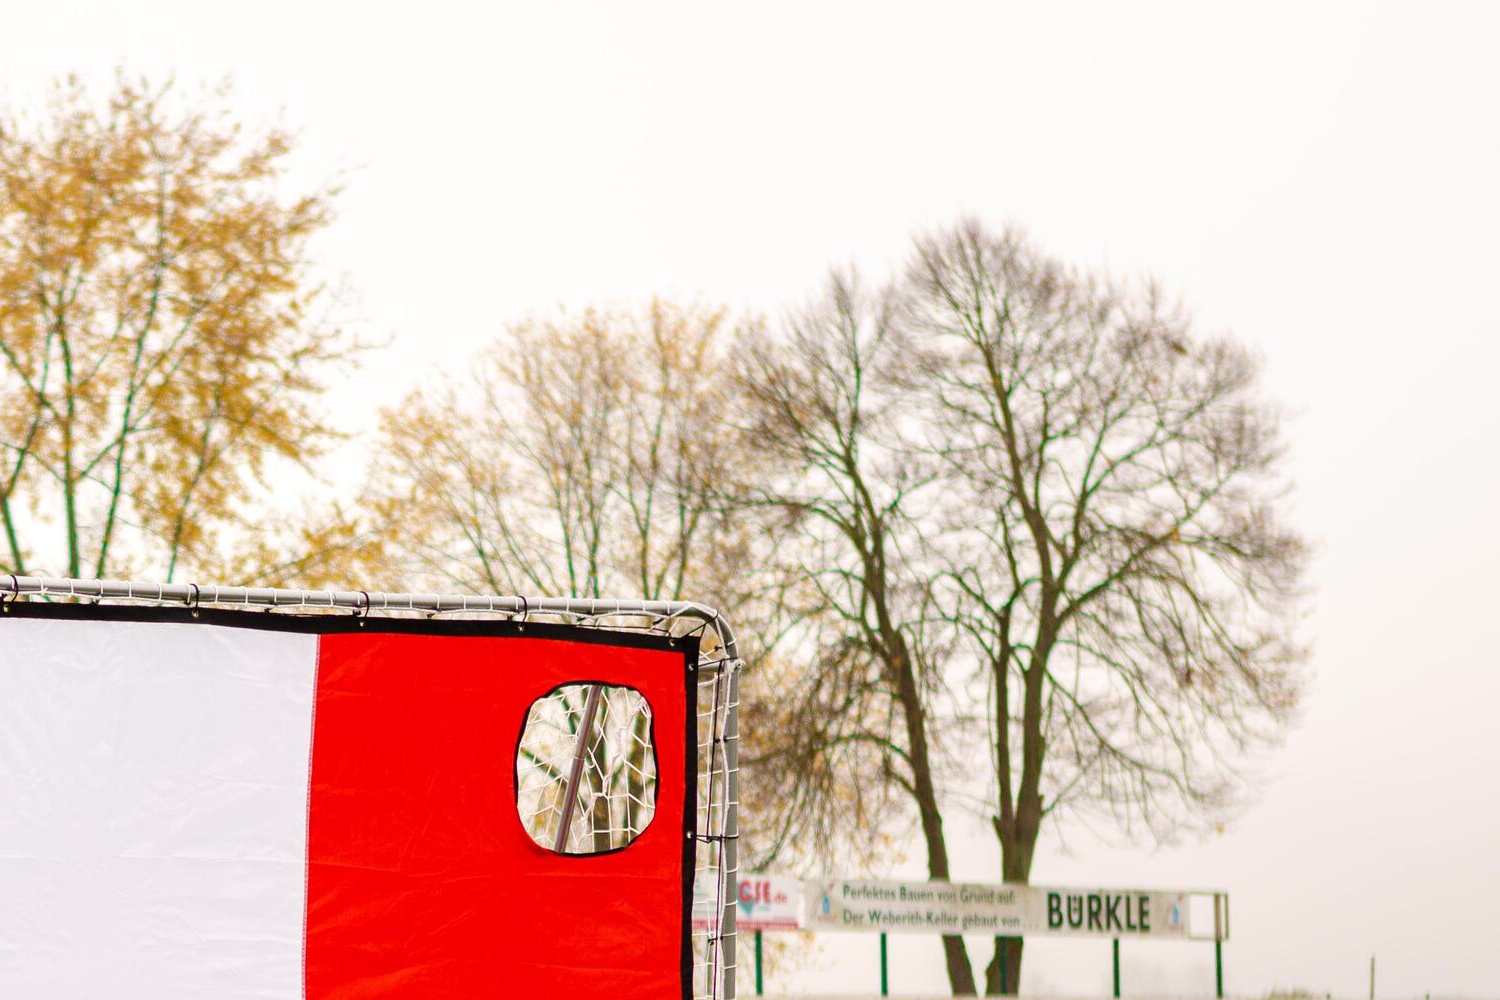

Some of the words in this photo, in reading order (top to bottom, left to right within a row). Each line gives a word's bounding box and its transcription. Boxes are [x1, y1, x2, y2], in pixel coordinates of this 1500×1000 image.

[843, 885, 896, 901] Perfektes
[899, 886, 934, 902] Bauen
[937, 890, 956, 903] von
[960, 889, 995, 905] Grund
[843, 908, 864, 925] Der
[962, 910, 997, 929] gebaut
[1001, 916, 1020, 927] von
[1047, 892, 1150, 932] BÜRKLE
